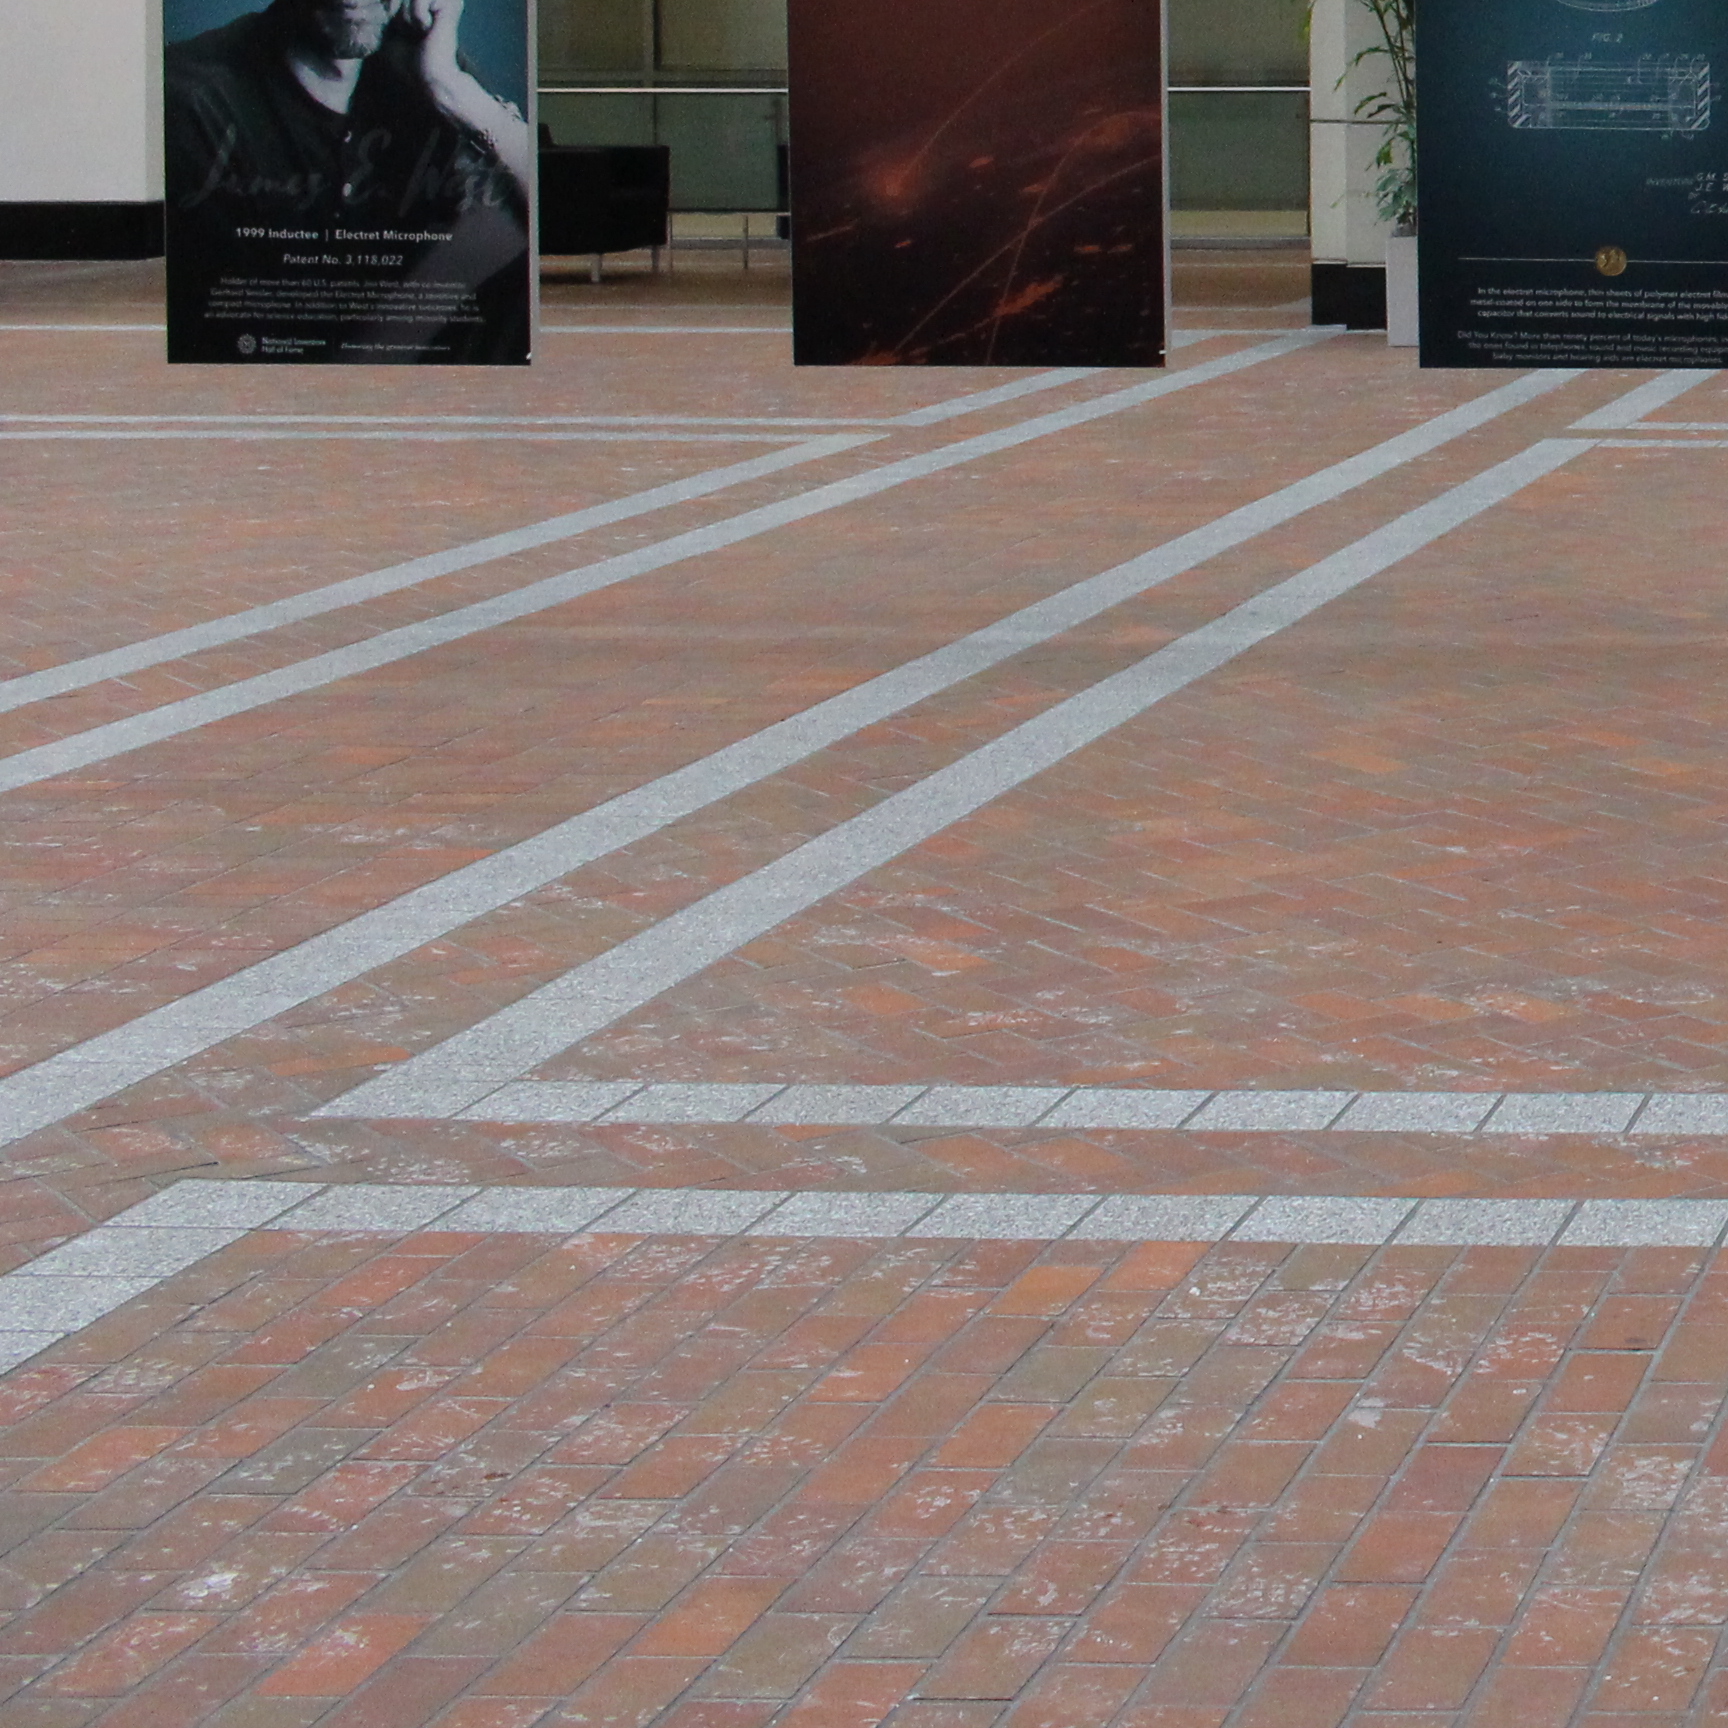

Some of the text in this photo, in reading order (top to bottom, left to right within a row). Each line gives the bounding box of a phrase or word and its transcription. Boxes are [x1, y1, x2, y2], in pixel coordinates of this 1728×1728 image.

[236, 227, 453, 243] 1999 Inductee Electret Microphone
[283, 254, 403, 266] Patent No. 3,118,022
